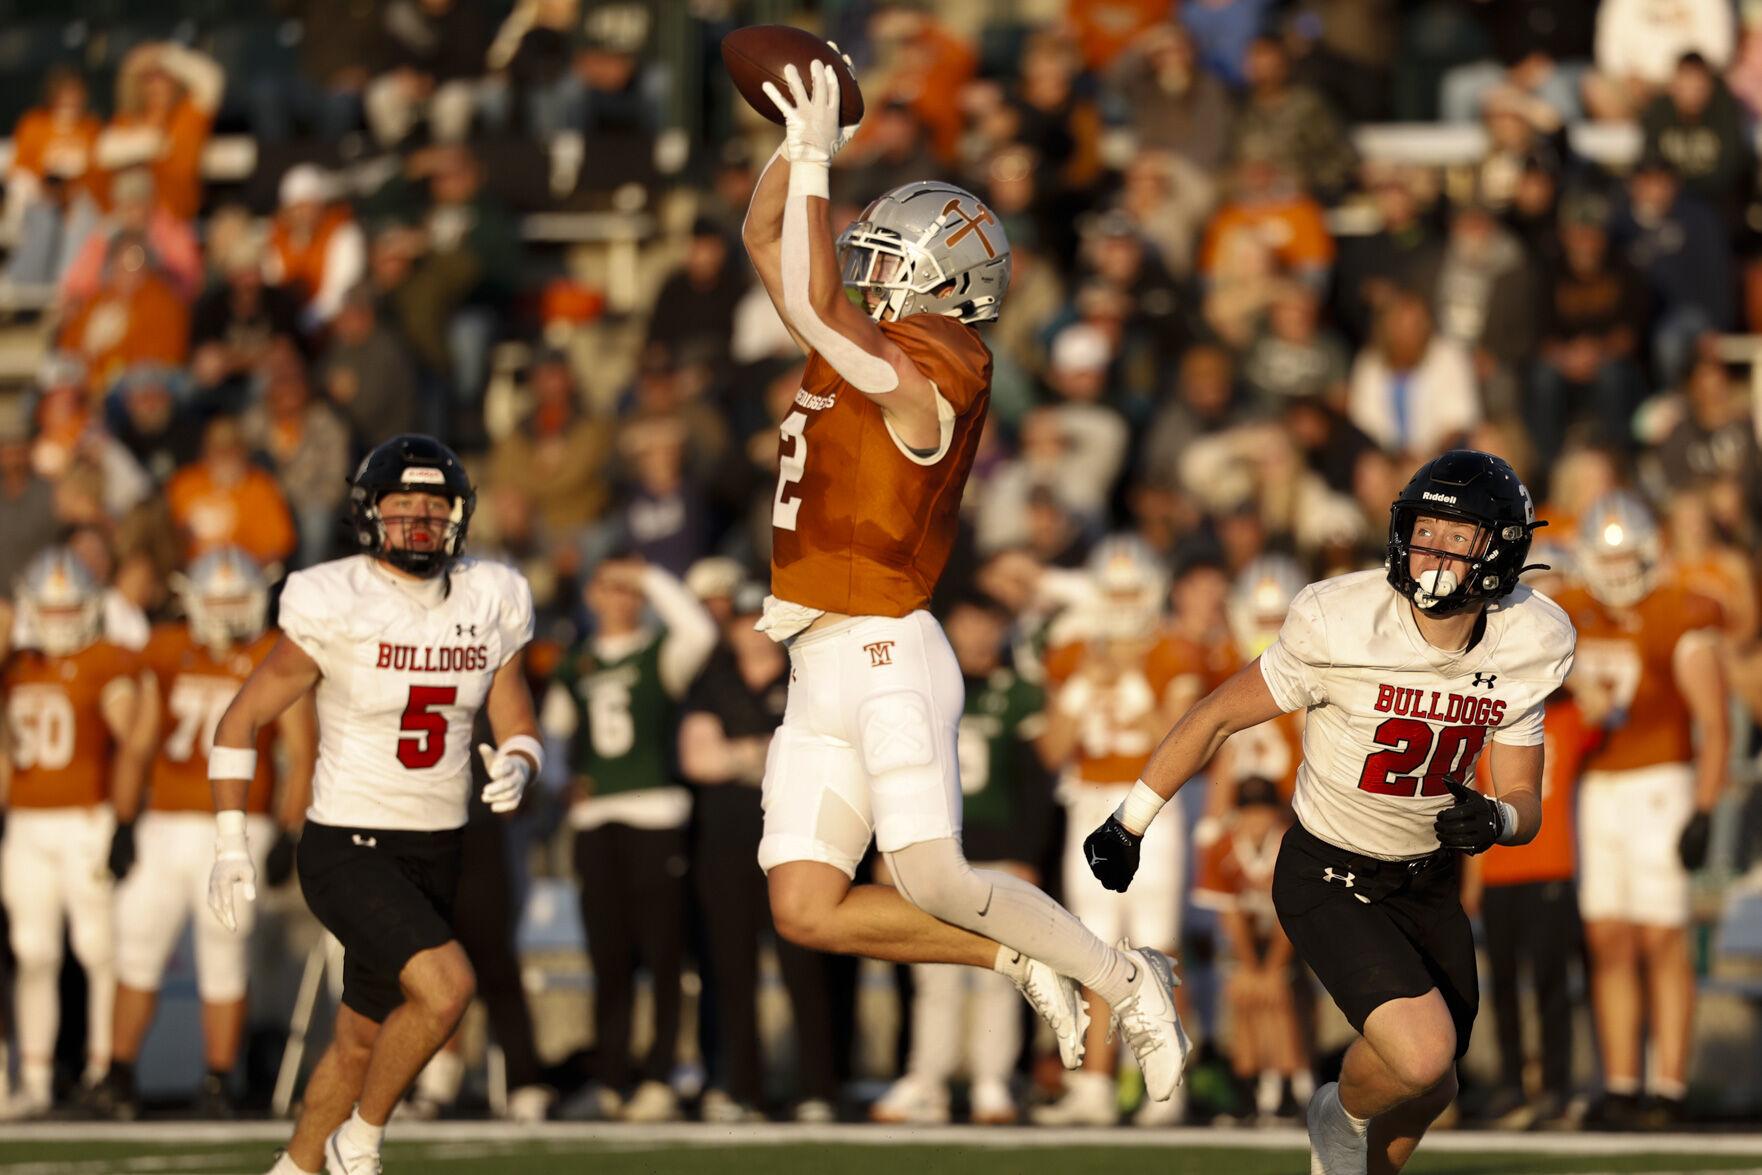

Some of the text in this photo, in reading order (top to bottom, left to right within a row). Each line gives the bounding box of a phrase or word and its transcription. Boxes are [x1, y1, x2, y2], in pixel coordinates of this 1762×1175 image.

[772, 411, 807, 531] 2
[1422, 491, 1457, 504] Riddell
[376, 643, 488, 672] BULLDOGS
[396, 685, 458, 769] 5
[1374, 683, 1507, 726] BULLDOGS
[1357, 717, 1488, 798] 20
